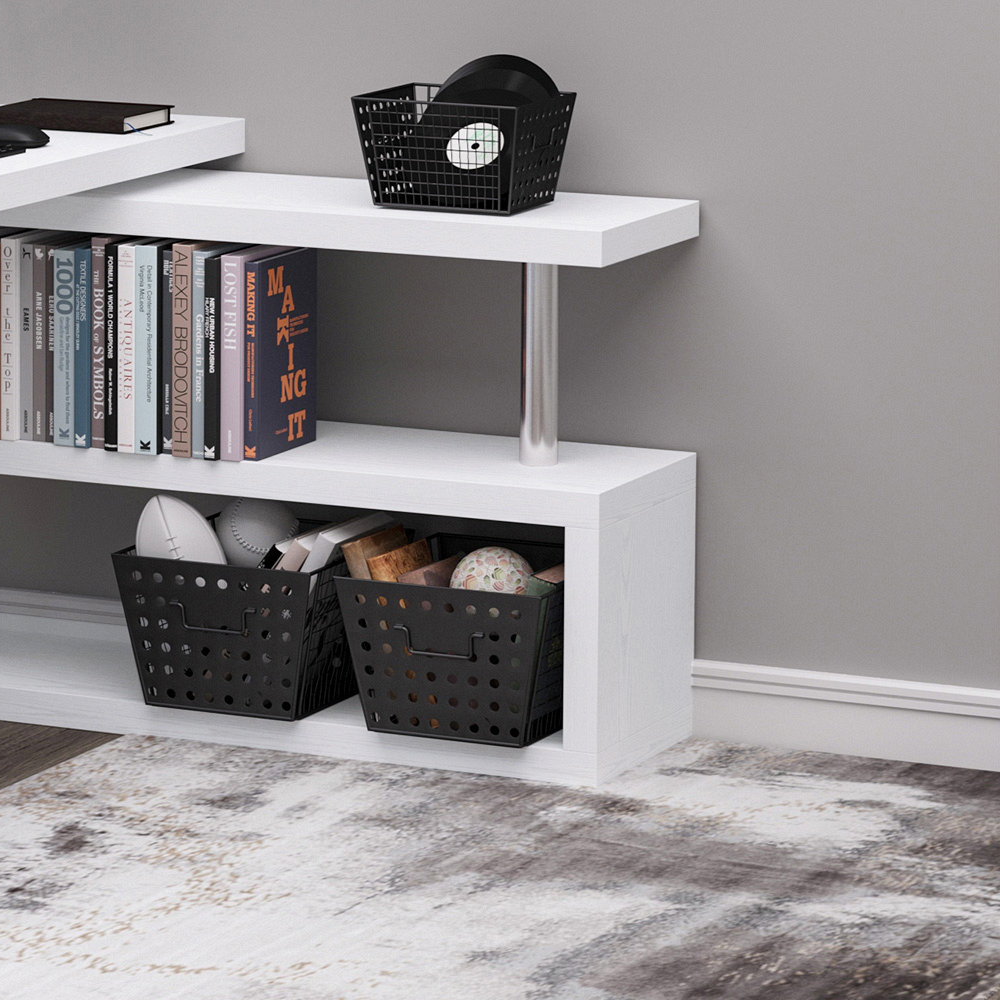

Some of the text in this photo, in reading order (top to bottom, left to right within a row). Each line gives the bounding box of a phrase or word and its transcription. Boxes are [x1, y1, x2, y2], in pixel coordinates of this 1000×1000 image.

[56, 257, 73, 315] 1000
[93, 288, 104, 330] BOOK
[174, 250, 188, 321] ALEXEY
[223, 262, 237, 351] LOST FISH
[246, 271, 255, 321] MAKING
[121, 299, 133, 400] ANTIQUAIRES
[195, 314, 204, 403] Gardens in France
[246, 323, 255, 337] IT
[93, 346, 104, 419] SYMBOLS
[174, 326, 188, 444] BRODOVITCH
[288, 408, 306, 443] IT
